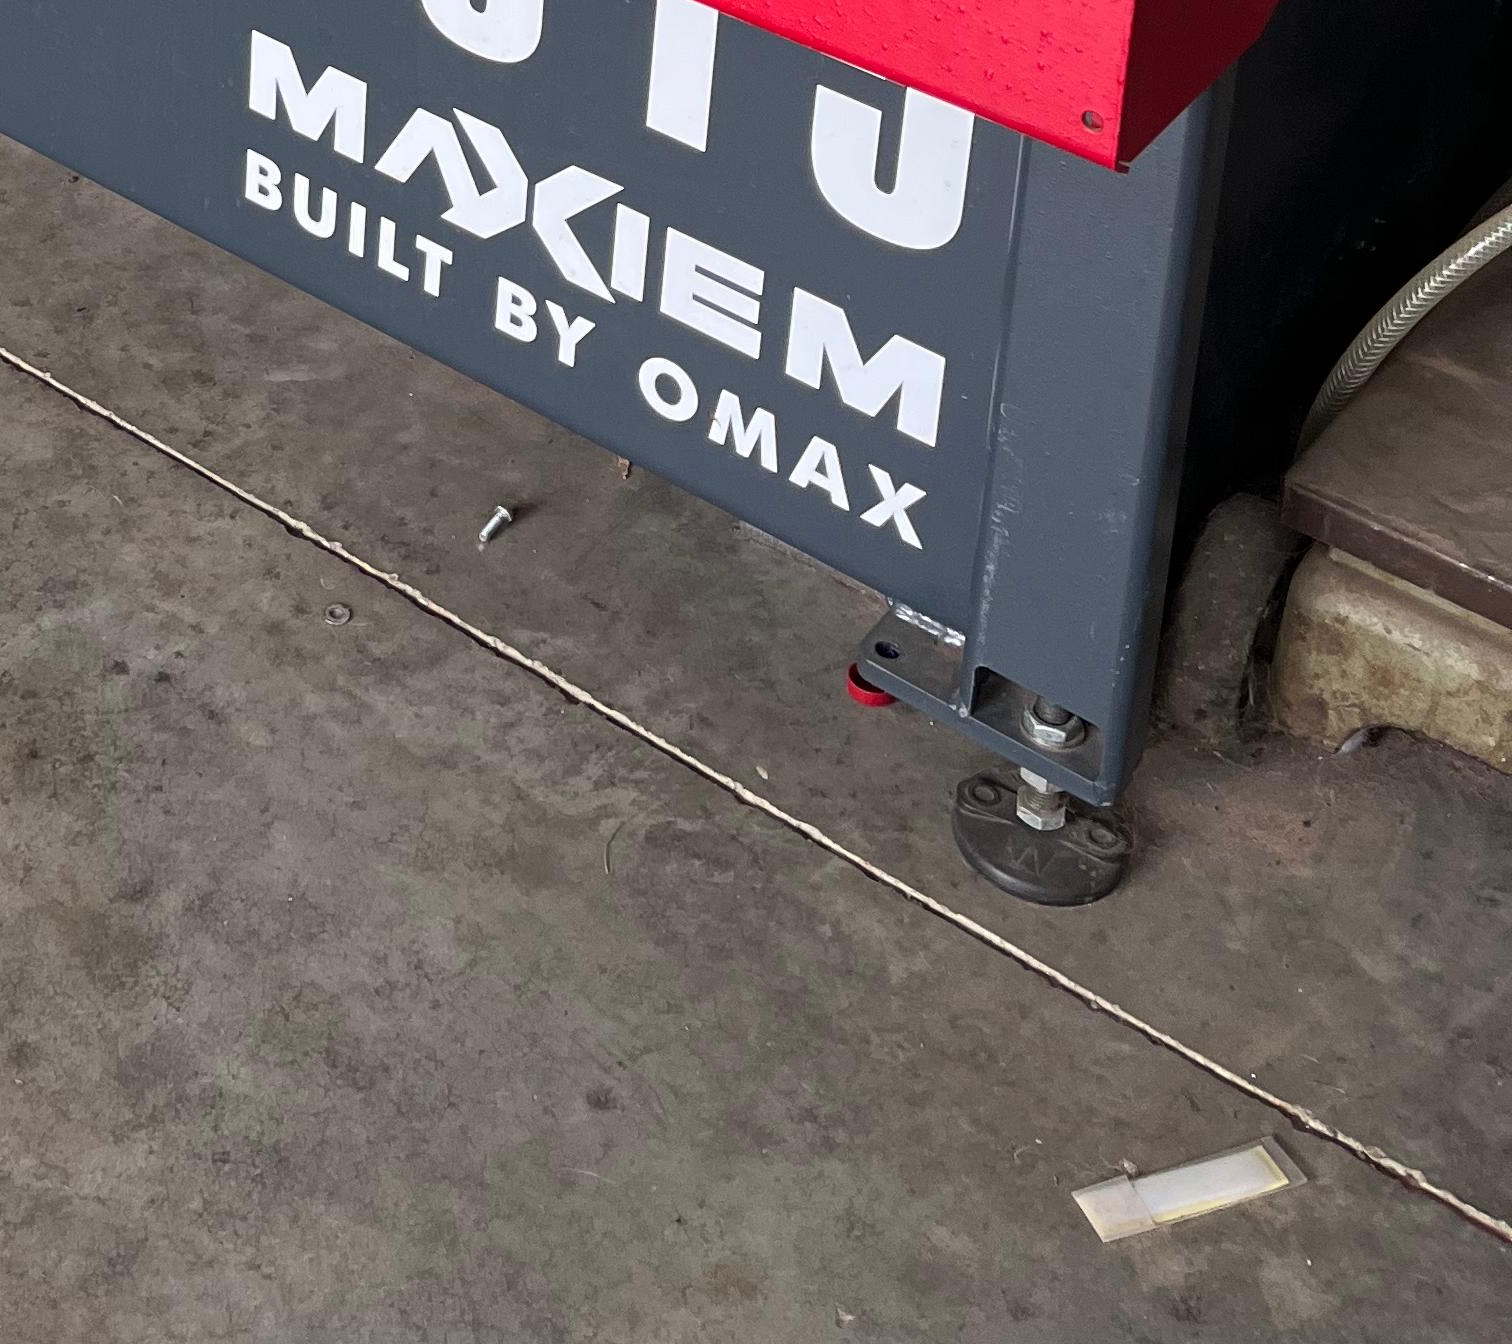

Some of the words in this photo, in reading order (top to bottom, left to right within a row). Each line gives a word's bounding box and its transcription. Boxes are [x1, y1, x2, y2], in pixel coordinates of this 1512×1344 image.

[244, 148, 453, 298] BUILT
[494, 276, 596, 368] BY
[638, 357, 928, 550] OMAX
[249, 29, 946, 448] MAXIEM
